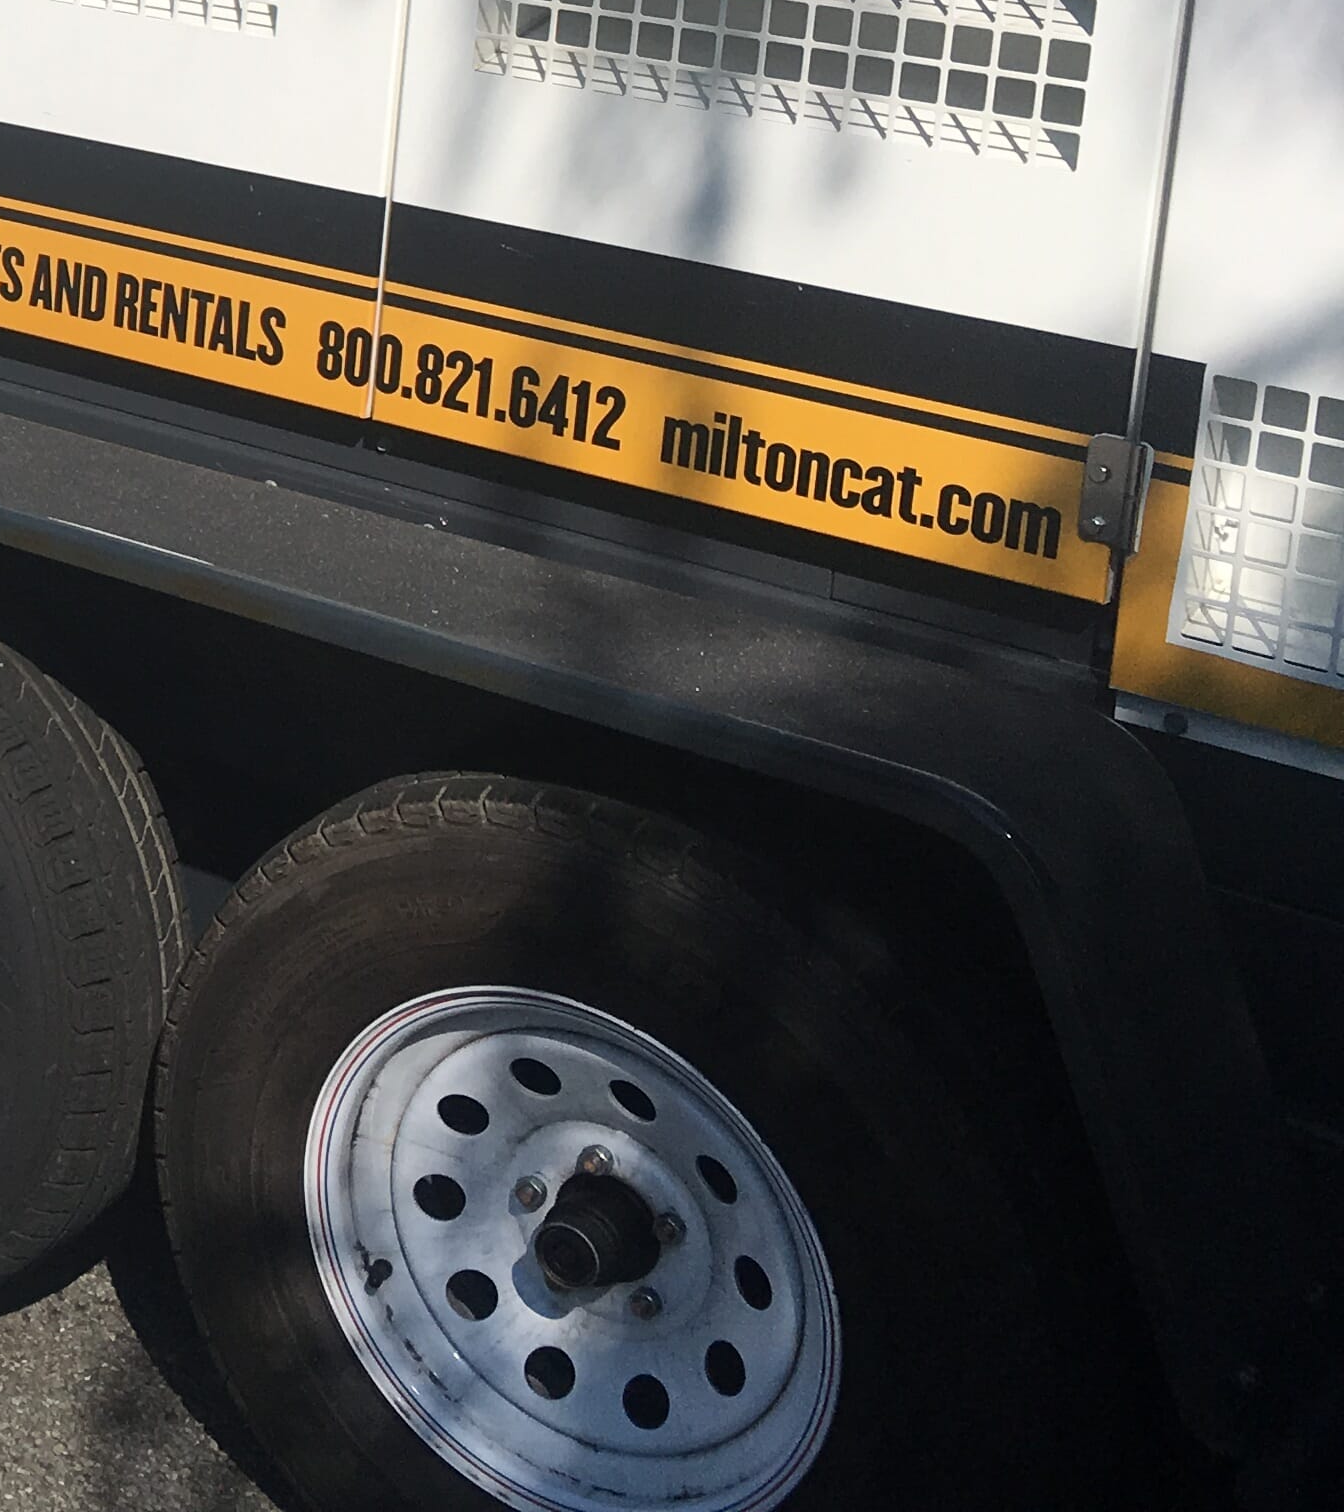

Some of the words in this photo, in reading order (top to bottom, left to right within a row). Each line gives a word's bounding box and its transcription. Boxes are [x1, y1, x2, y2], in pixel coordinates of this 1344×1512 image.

[29, 254, 108, 322] AND
[113, 273, 287, 366] RENTALS
[316, 321, 627, 451] 800.821.6412
[659, 411, 1062, 560] miltoncat.com
